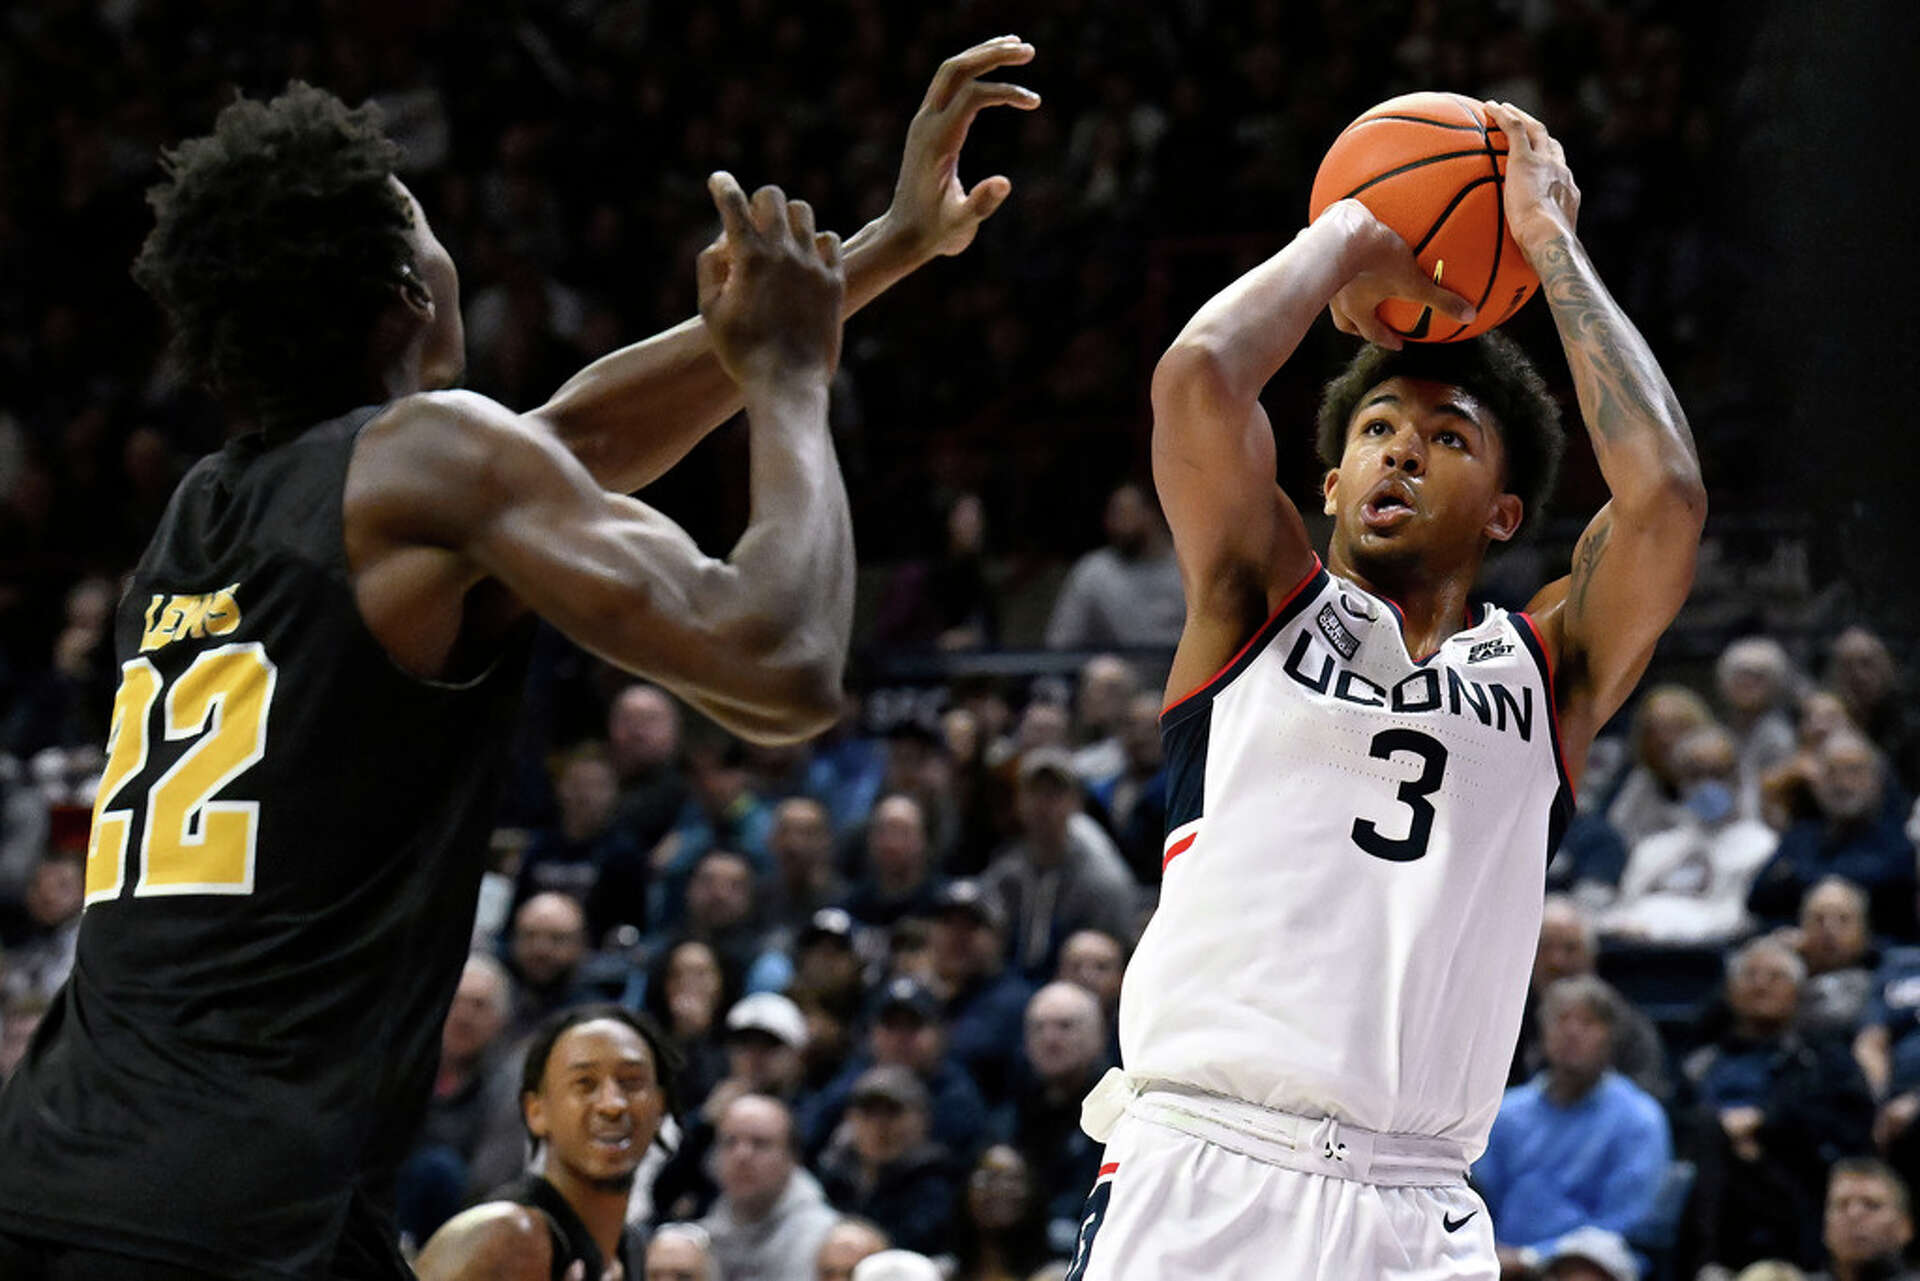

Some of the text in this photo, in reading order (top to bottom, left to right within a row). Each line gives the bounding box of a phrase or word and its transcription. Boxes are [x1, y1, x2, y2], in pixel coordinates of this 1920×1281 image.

[138, 583, 241, 652] LEWS
[1283, 628, 1532, 742] UCONN
[83, 641, 277, 910] 22
[1351, 728, 1448, 861] 3
